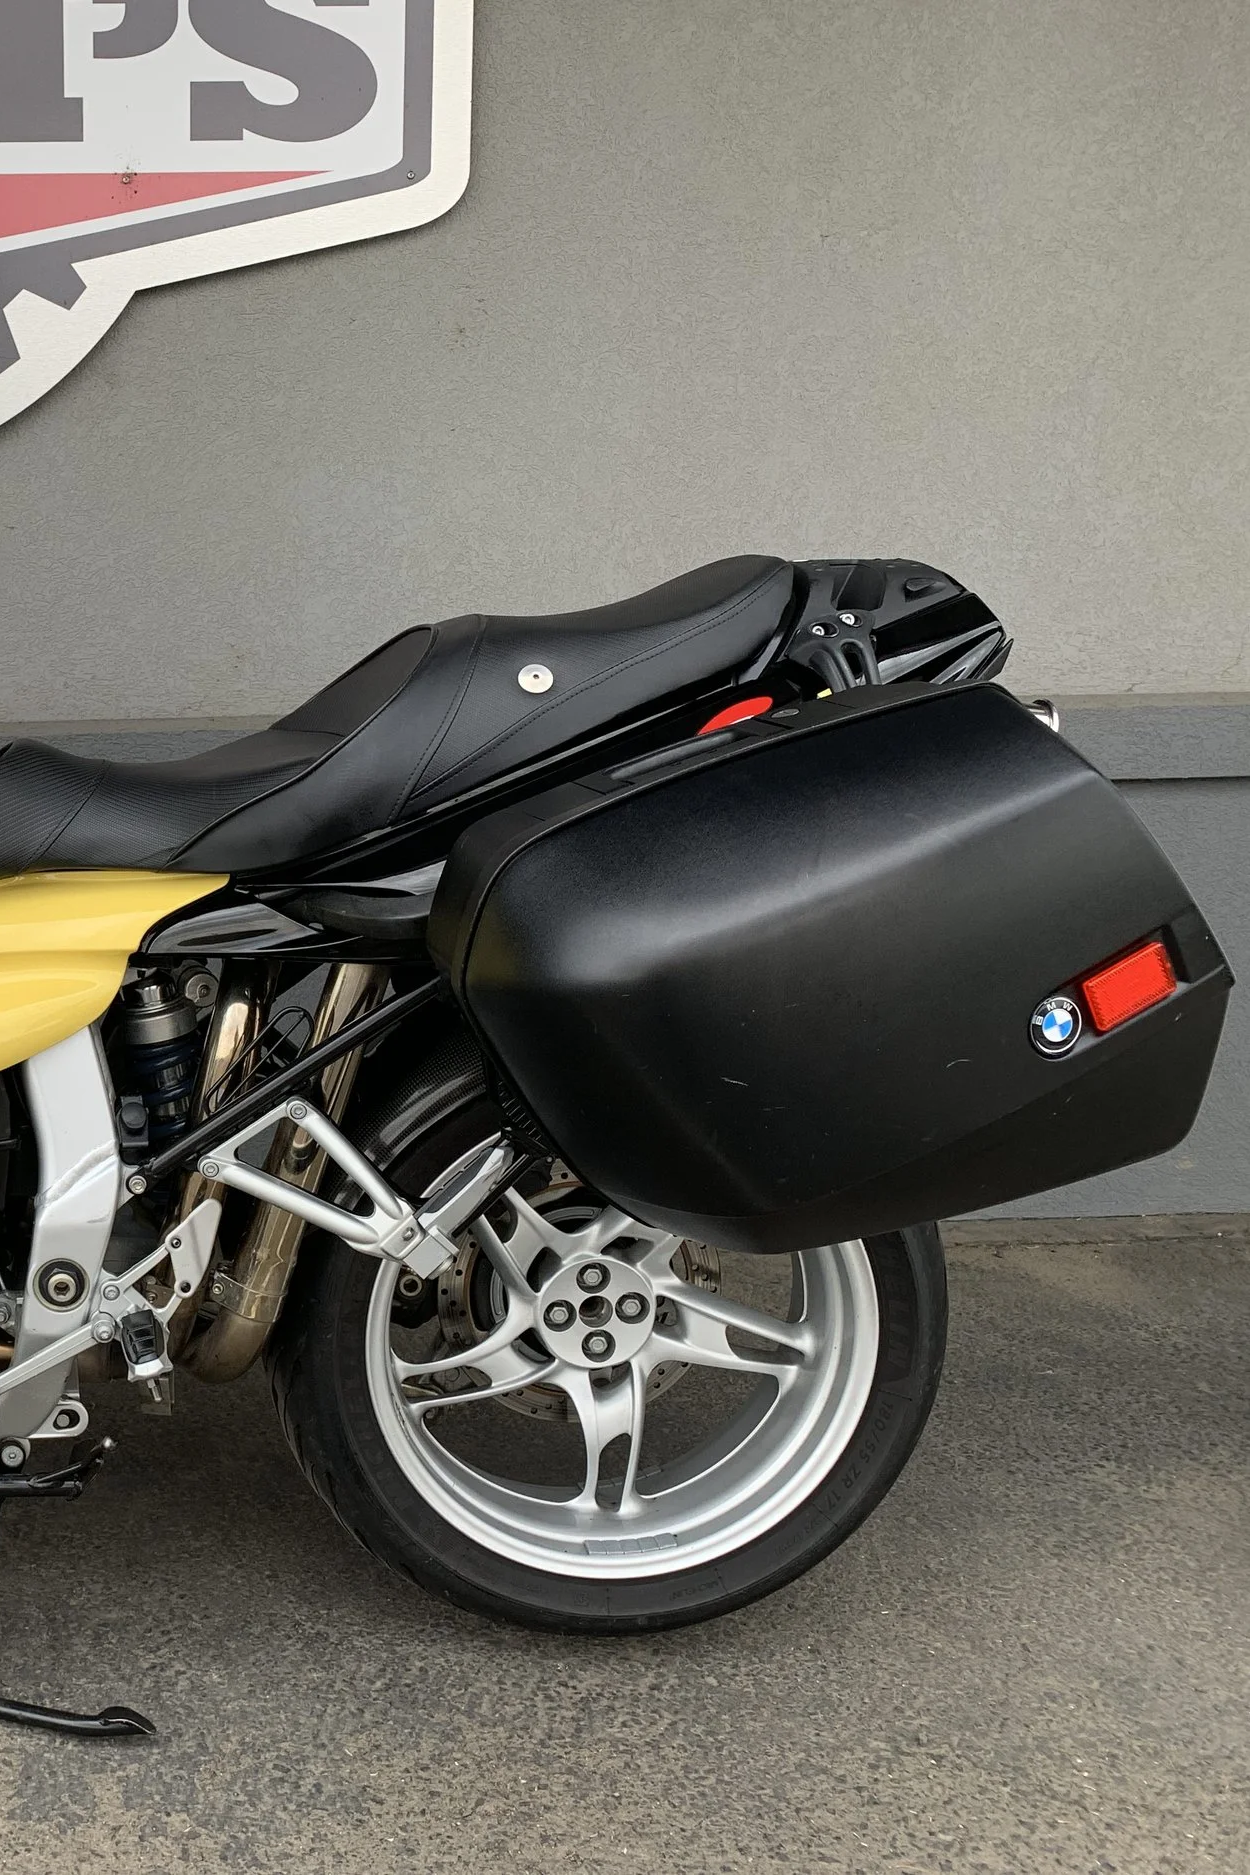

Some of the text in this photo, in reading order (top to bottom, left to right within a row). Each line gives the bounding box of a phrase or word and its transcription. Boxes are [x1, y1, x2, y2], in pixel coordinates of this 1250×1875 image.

[1034, 1001, 1073, 1027] BMW
[826, 1399, 895, 1511] 180/55 ZR 17
